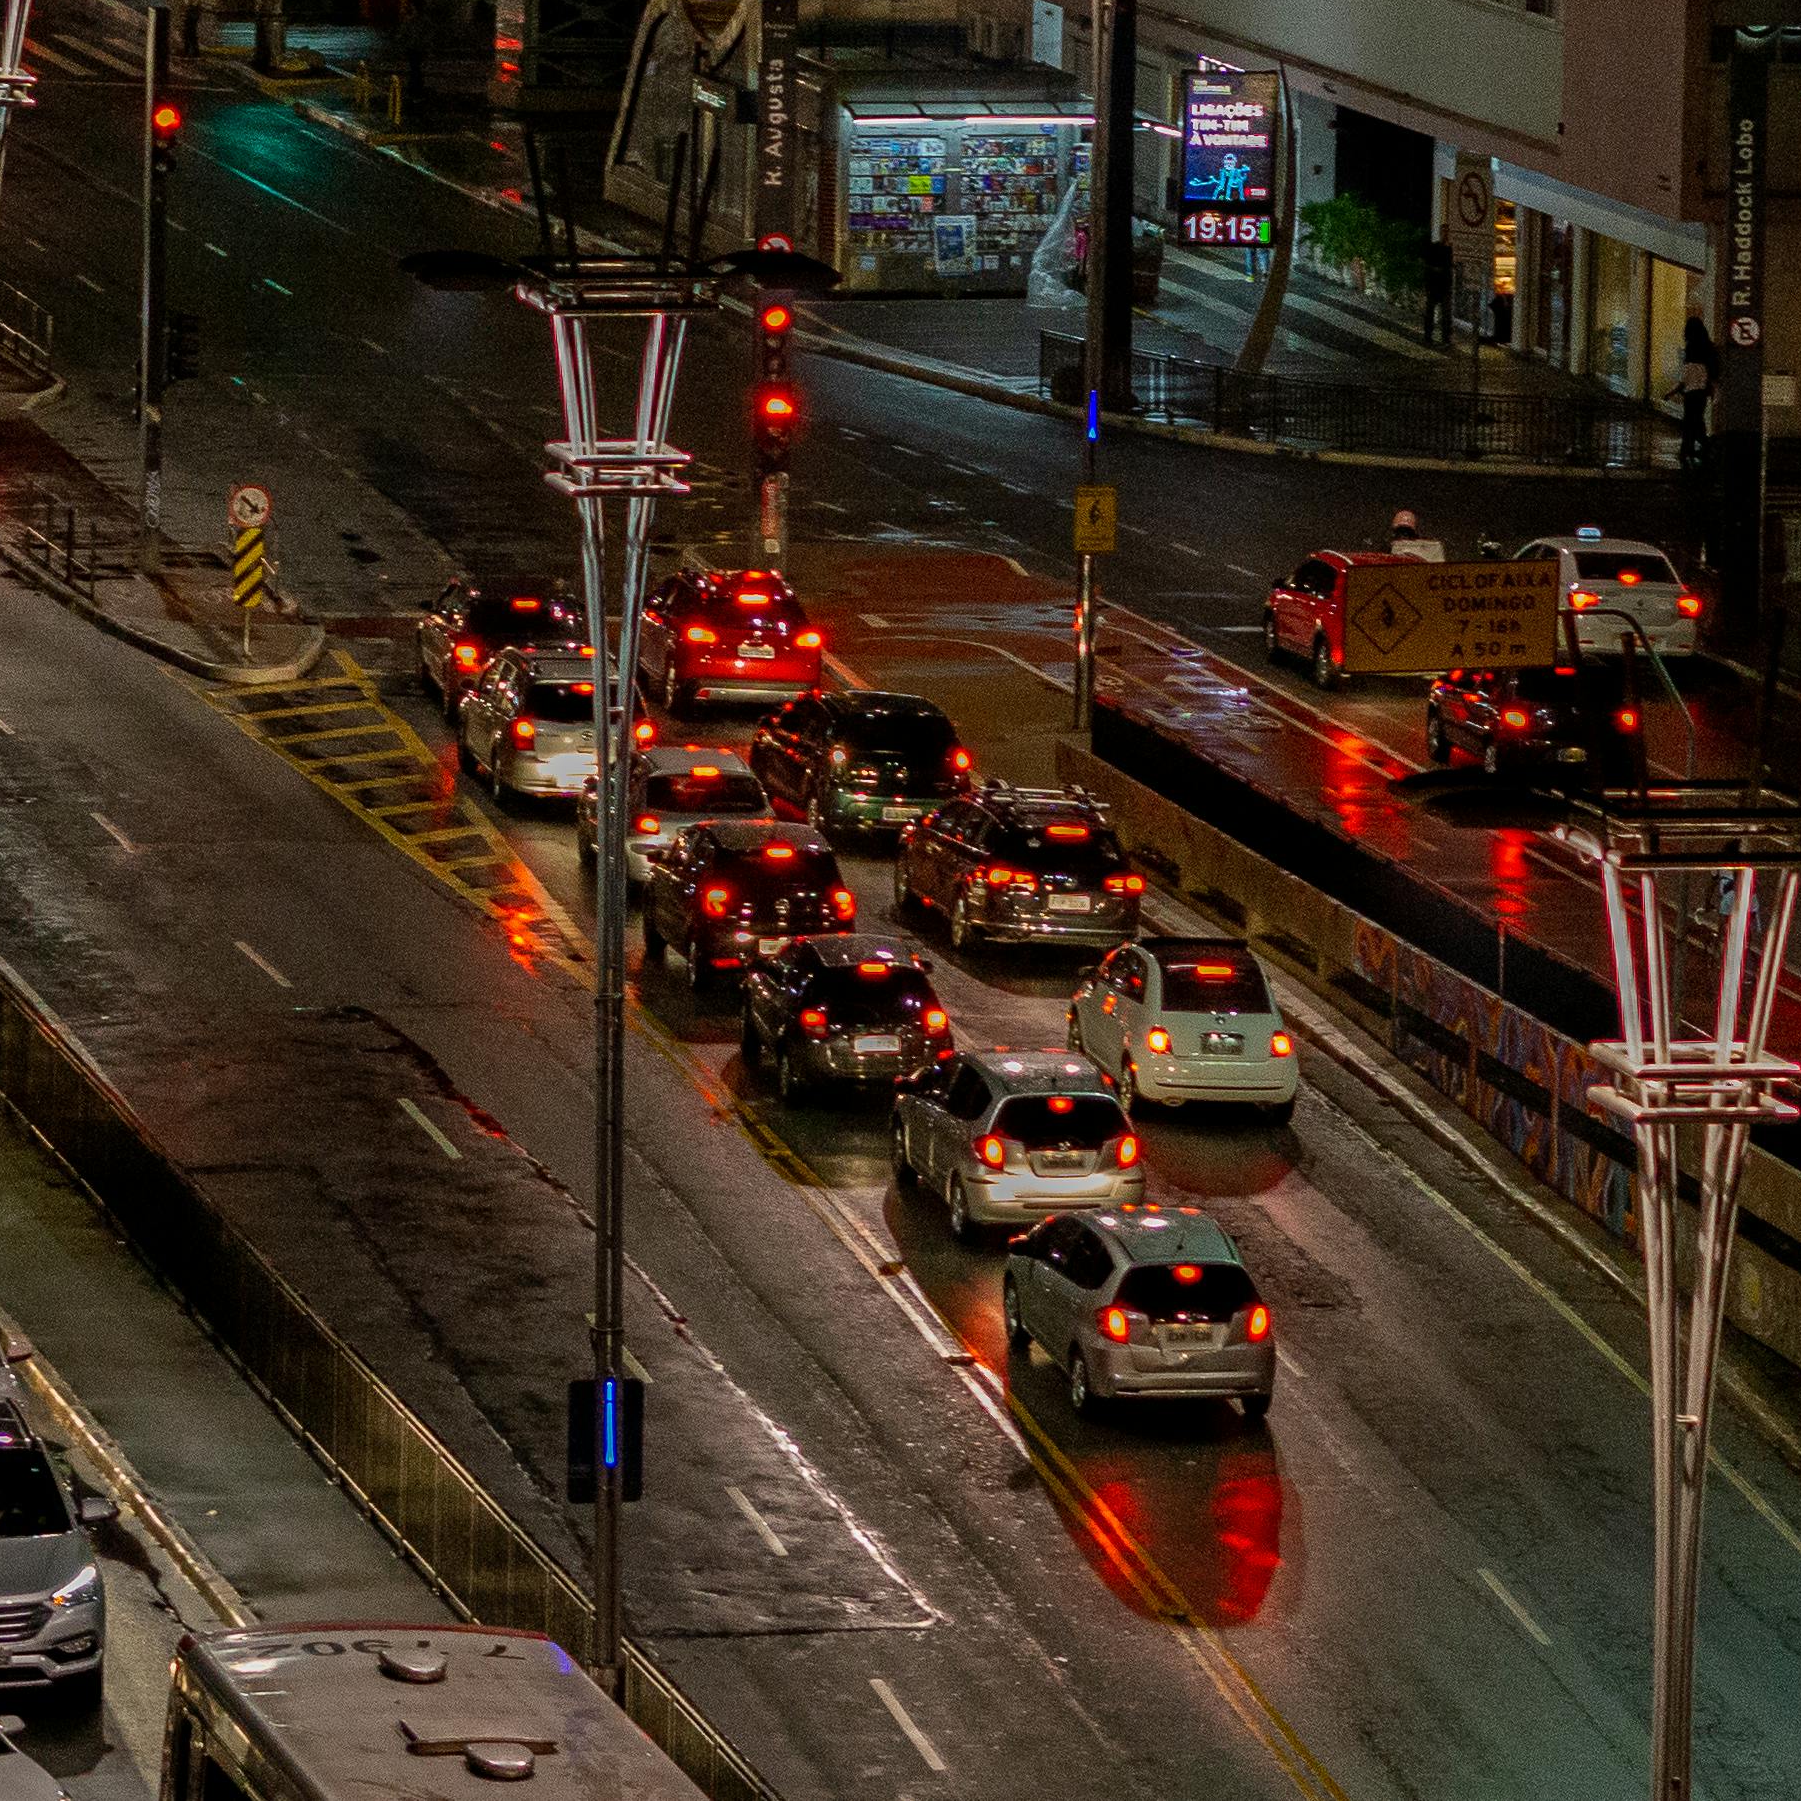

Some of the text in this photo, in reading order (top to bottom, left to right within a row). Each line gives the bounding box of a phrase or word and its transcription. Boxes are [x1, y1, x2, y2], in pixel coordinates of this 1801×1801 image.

[764, 58, 789, 158] Augusta
[1191, 102, 1264, 119] LIGAÇÕES
[1731, 118, 1756, 306] R. Haddock Lobo
[1184, 215, 1257, 242] 19:15
[1428, 572, 1552, 590] CICLOFAIXA
[1443, 594, 1535, 611] DOMINGO
[1459, 619, 1470, 635] 7
[1451, 640, 1526, 657] A 50 m
